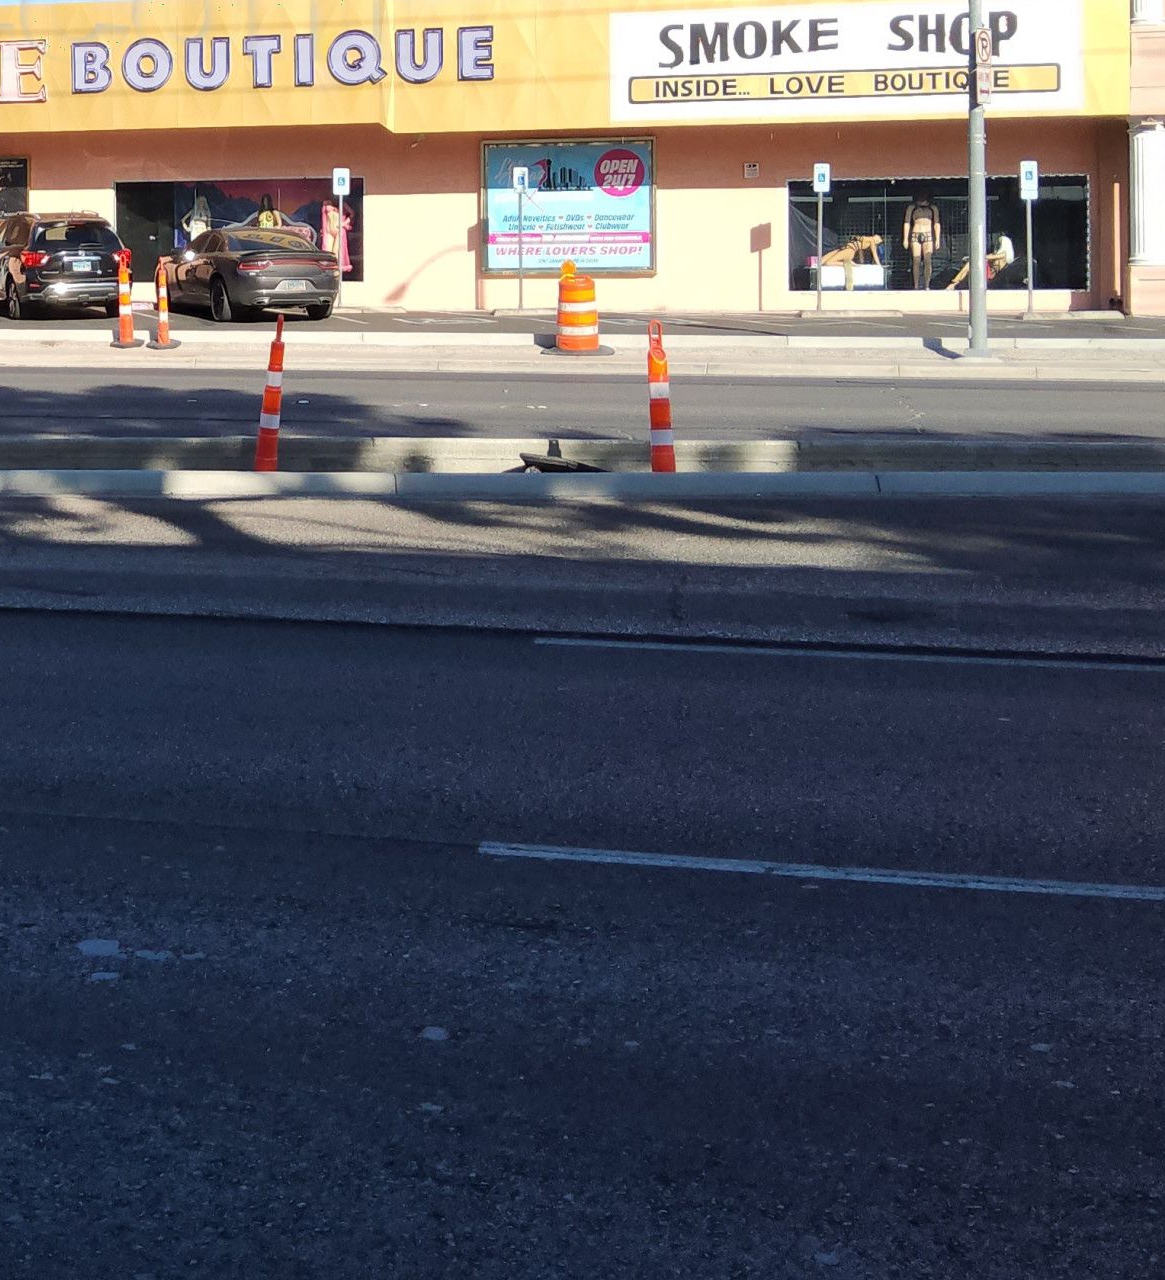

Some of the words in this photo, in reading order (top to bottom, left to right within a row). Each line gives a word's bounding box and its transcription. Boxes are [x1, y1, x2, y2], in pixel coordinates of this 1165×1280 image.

[657, 18, 839, 70] SMOKE
[886, 10, 1018, 57] SHOP
[71, 25, 495, 94] BOUTIQUE
[769, 75, 845, 96] LOVE
[873, 70, 1010, 93] BOUTIQE
[599, 159, 639, 174] OPEN
[602, 173, 637, 191] 24/7
[565, 214, 585, 222] DVDs
[508, 223, 537, 231] Linerie
[496, 246, 544, 256] WHERE
[545, 246, 597, 256] LOVERS
[599, 245, 643, 256] SHOP!
